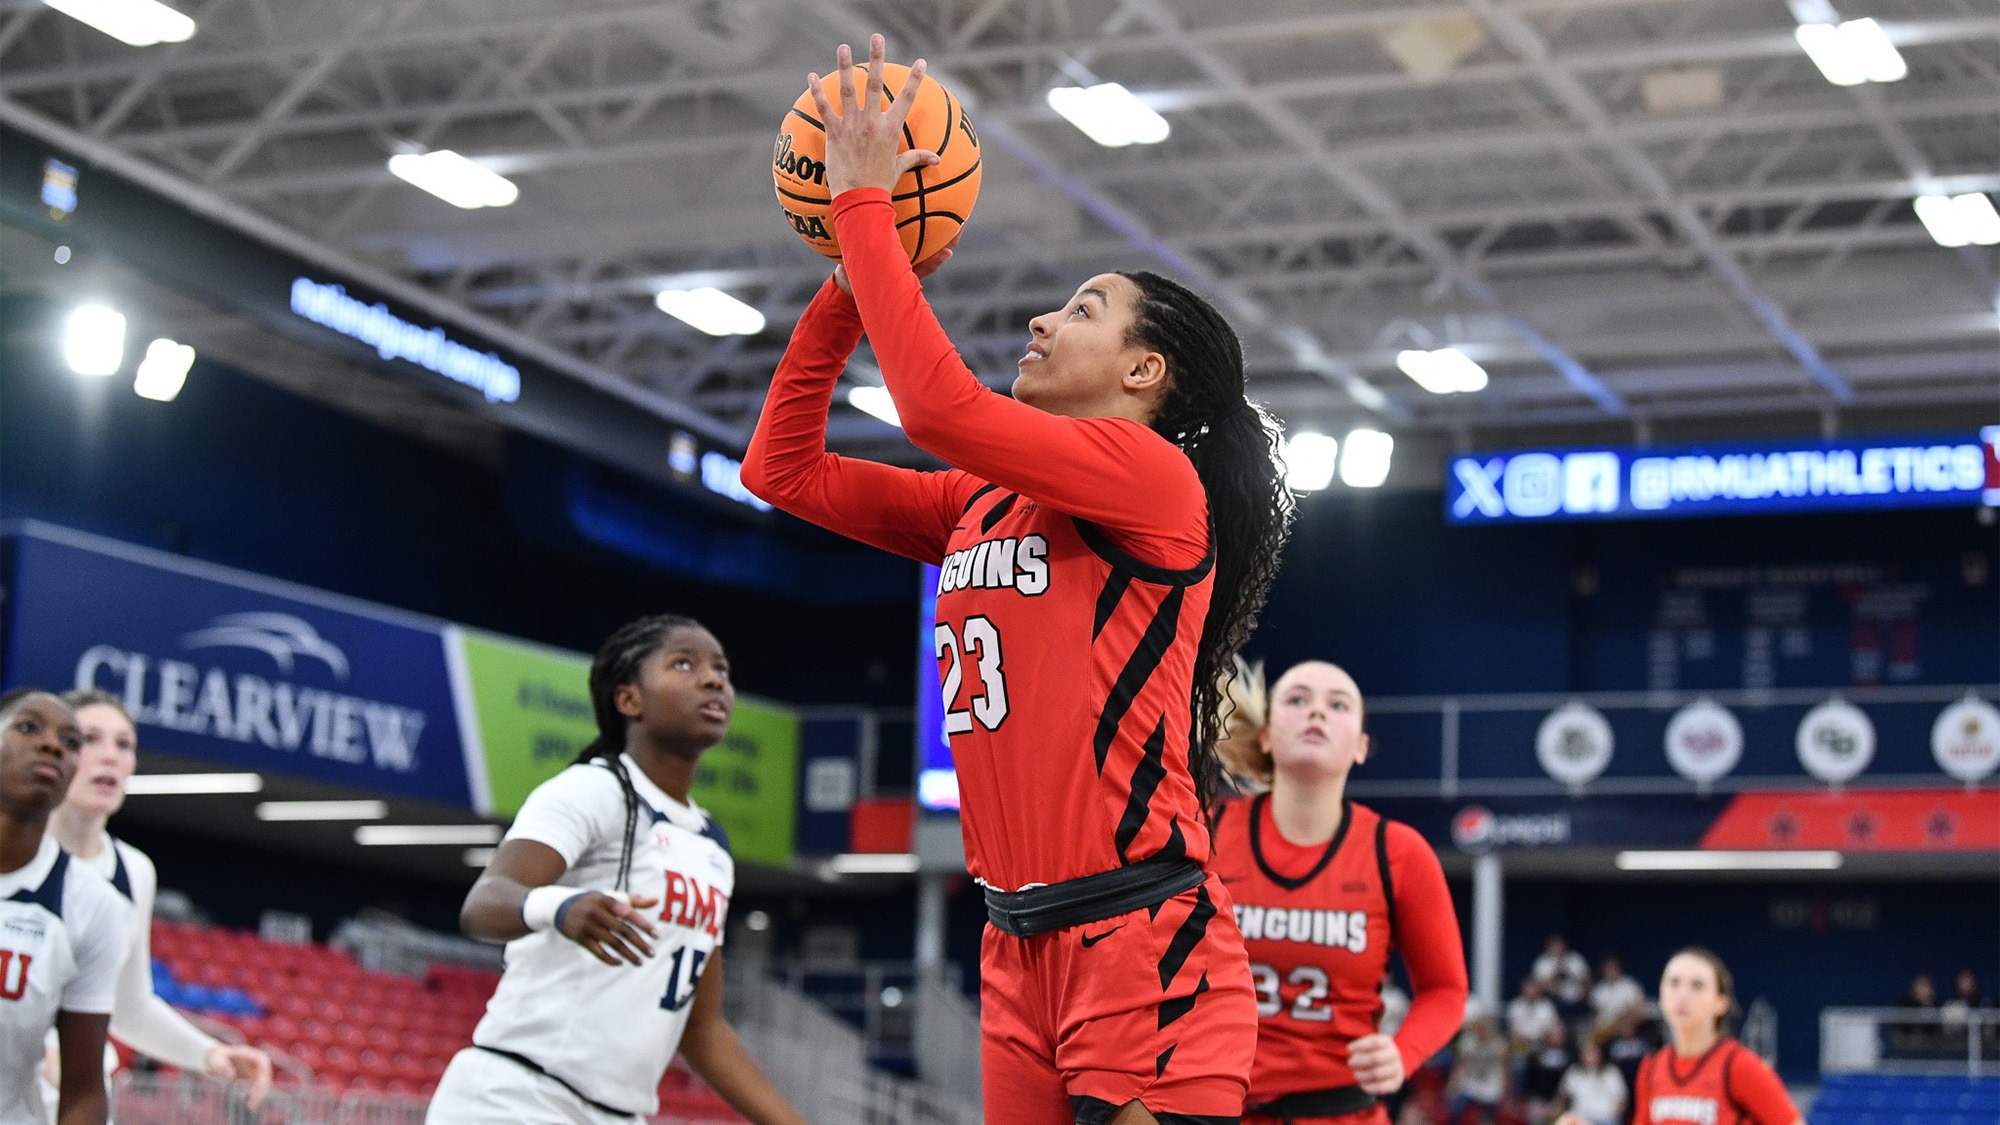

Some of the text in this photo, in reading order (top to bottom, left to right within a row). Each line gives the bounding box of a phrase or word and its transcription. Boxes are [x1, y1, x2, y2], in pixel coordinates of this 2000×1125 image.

[775, 133, 828, 186] ilson
[783, 207, 832, 240] CAA
[935, 614, 1010, 733] 23
[74, 643, 426, 772] CLEARVIEW
[659, 869, 728, 938] RM
[1232, 903, 1367, 954] NGUINS
[659, 945, 706, 1012] 15
[1249, 962, 1333, 1022] 32
